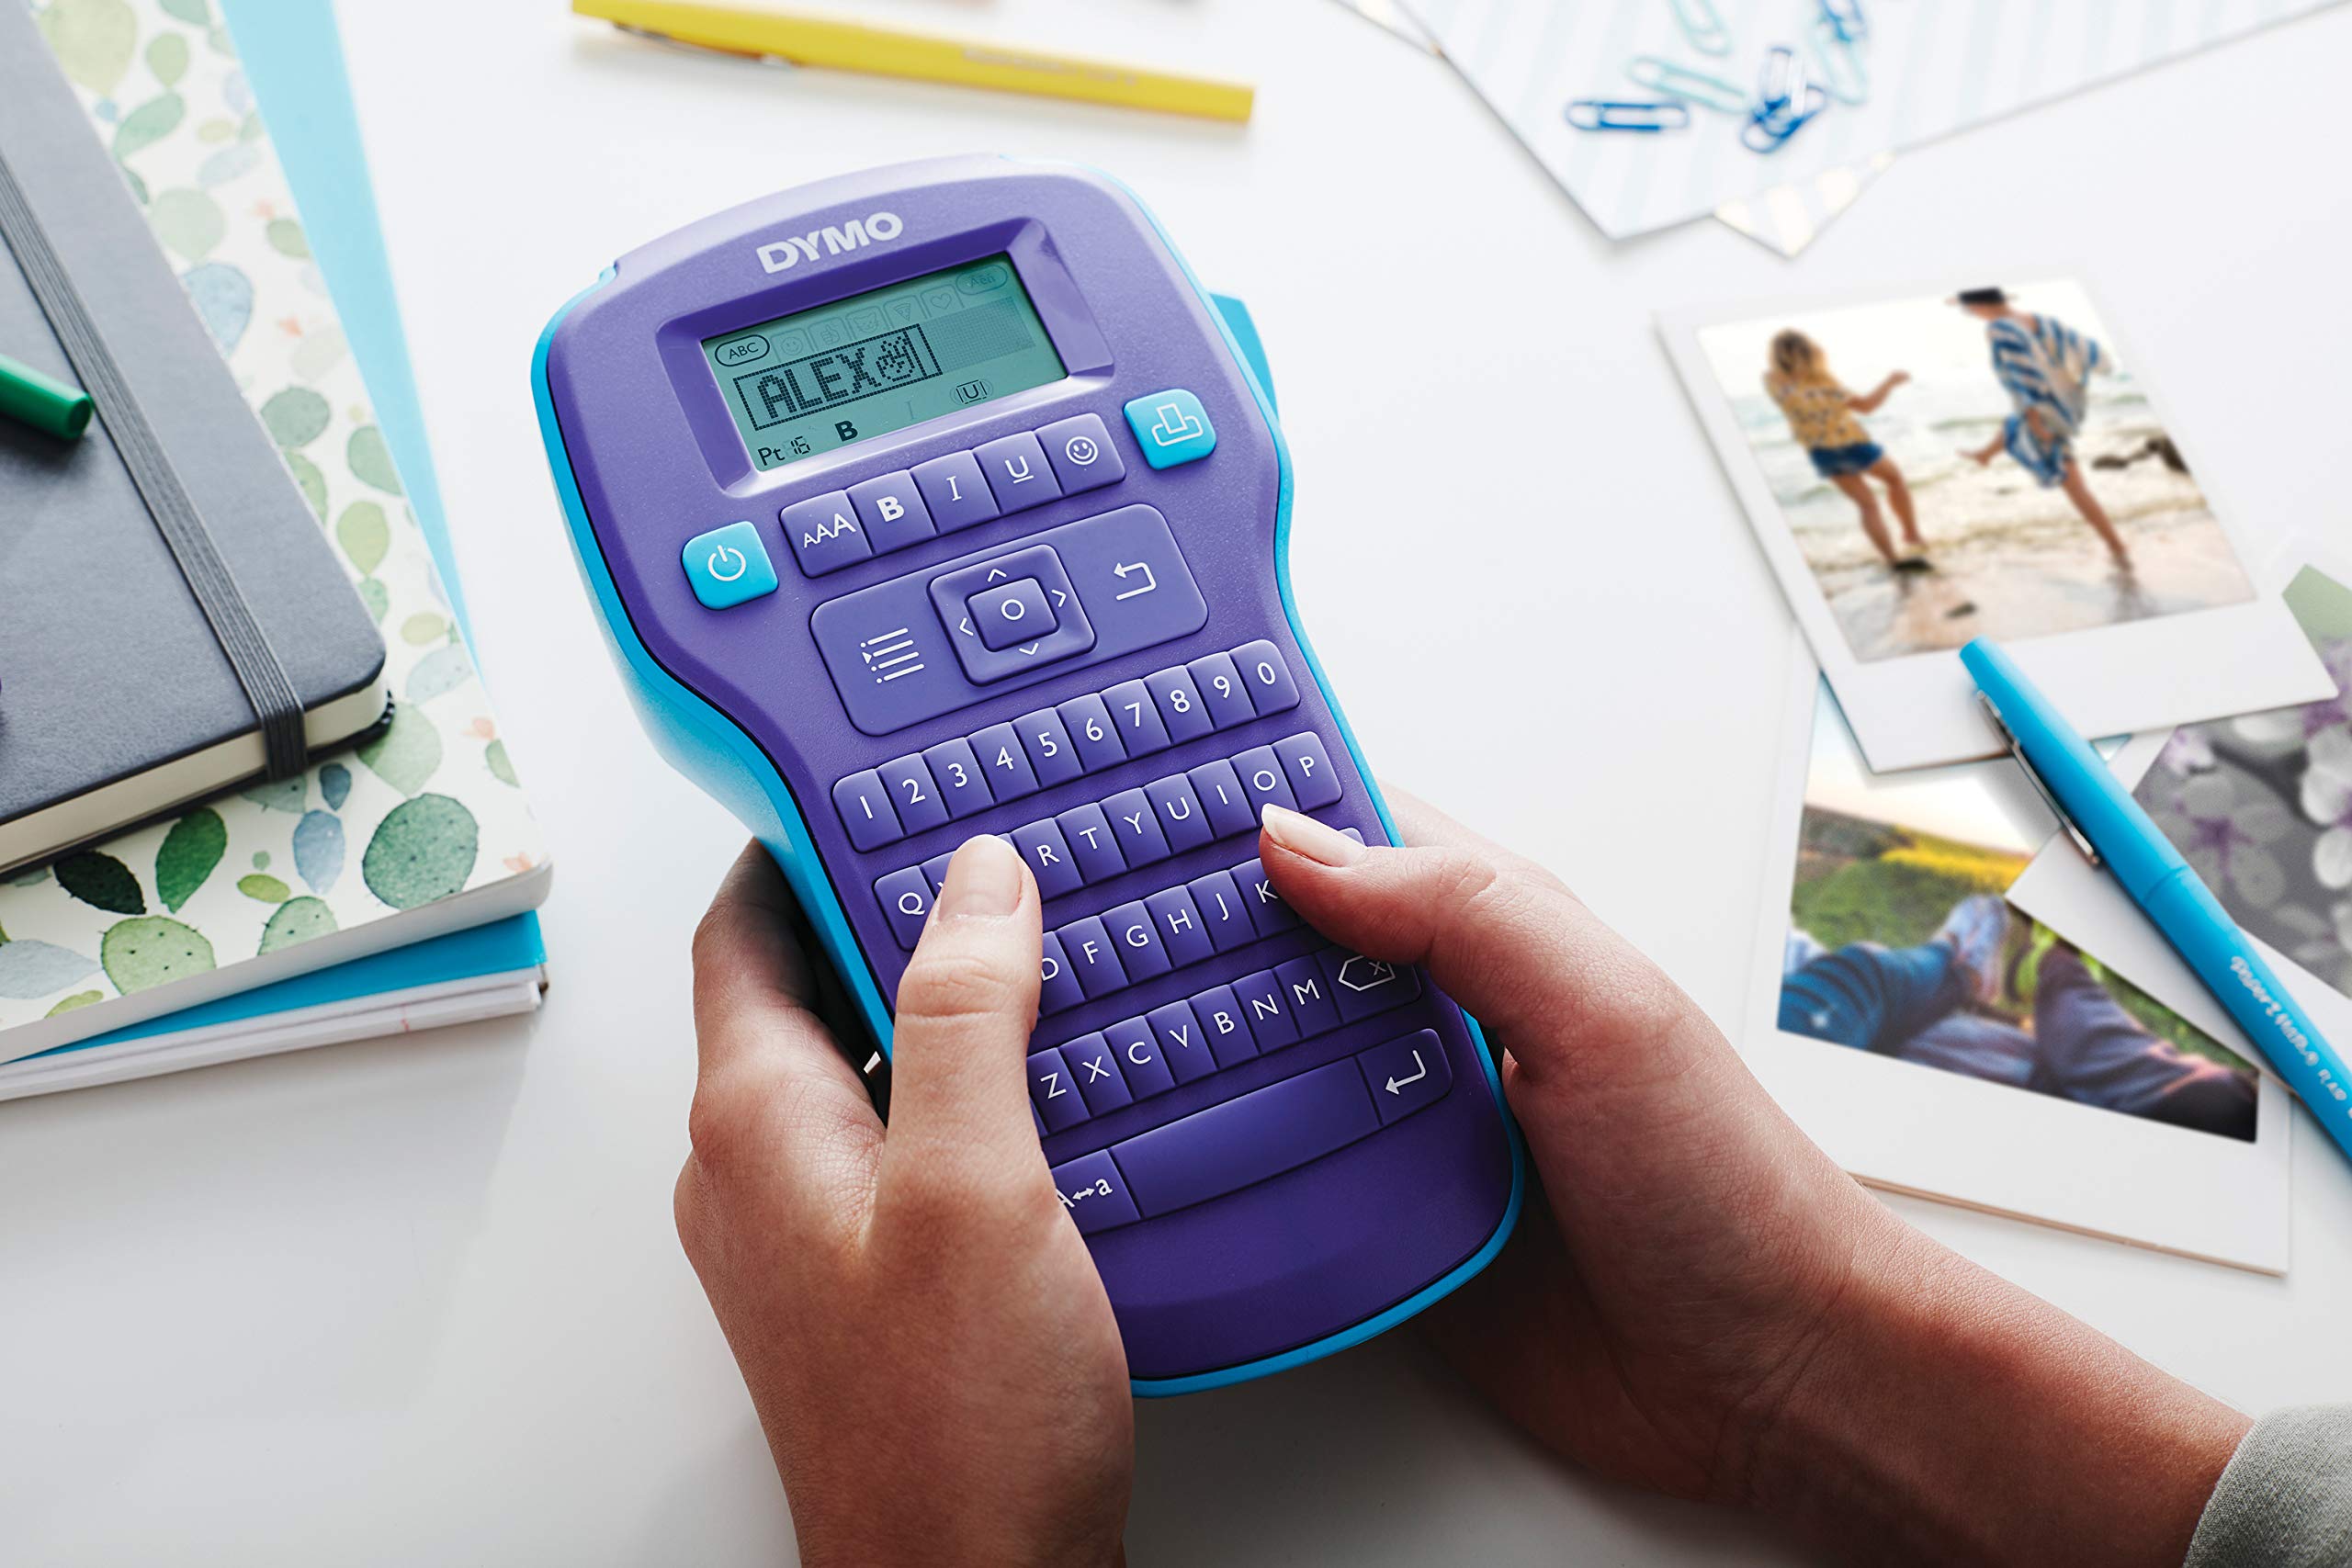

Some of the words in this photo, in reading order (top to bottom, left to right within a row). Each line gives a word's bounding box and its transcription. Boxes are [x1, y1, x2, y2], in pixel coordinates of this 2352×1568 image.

[755, 211, 904, 275] DYMO
[729, 343, 759, 360] ABC
[757, 346, 883, 420] ALEX
[757, 446, 786, 467] Pt
[789, 435, 811, 456] 16
[834, 420, 859, 442] B
[802, 512, 858, 550] AAA
[876, 495, 906, 523] B
[945, 475, 963, 502] I
[1003, 455, 1035, 485] U
[901, 778, 926, 805] 2
[947, 762, 968, 788] 3
[995, 746, 1015, 771] 4
[1037, 731, 1057, 758] 5
[1085, 717, 1104, 742] 6
[1124, 701, 1141, 728] 7
[1170, 689, 1192, 714] 8
[1212, 674, 1231, 699] 9
[897, 891, 926, 916] Q
[1035, 843, 1061, 867] R
[1079, 826, 1099, 851] T
[1122, 811, 1143, 835] Y
[1166, 796, 1191, 820] U
[1216, 784, 1229, 806] I
[1298, 755, 1316, 778] P
[1081, 939, 1100, 964] F
[1125, 924, 1149, 948] G
[1167, 908, 1193, 935] H
[1216, 892, 1230, 921] J
[1254, 879, 1279, 904] K
[1040, 1072, 1067, 1100] Z
[1081, 1055, 1111, 1085] X
[1127, 1041, 1152, 1066] C
[1168, 1024, 1189, 1049] V
[1213, 1010, 1236, 1035] B
[1251, 994, 1280, 1021] N
[1293, 978, 1321, 1006] M
[1095, 1179, 1113, 1196] a
